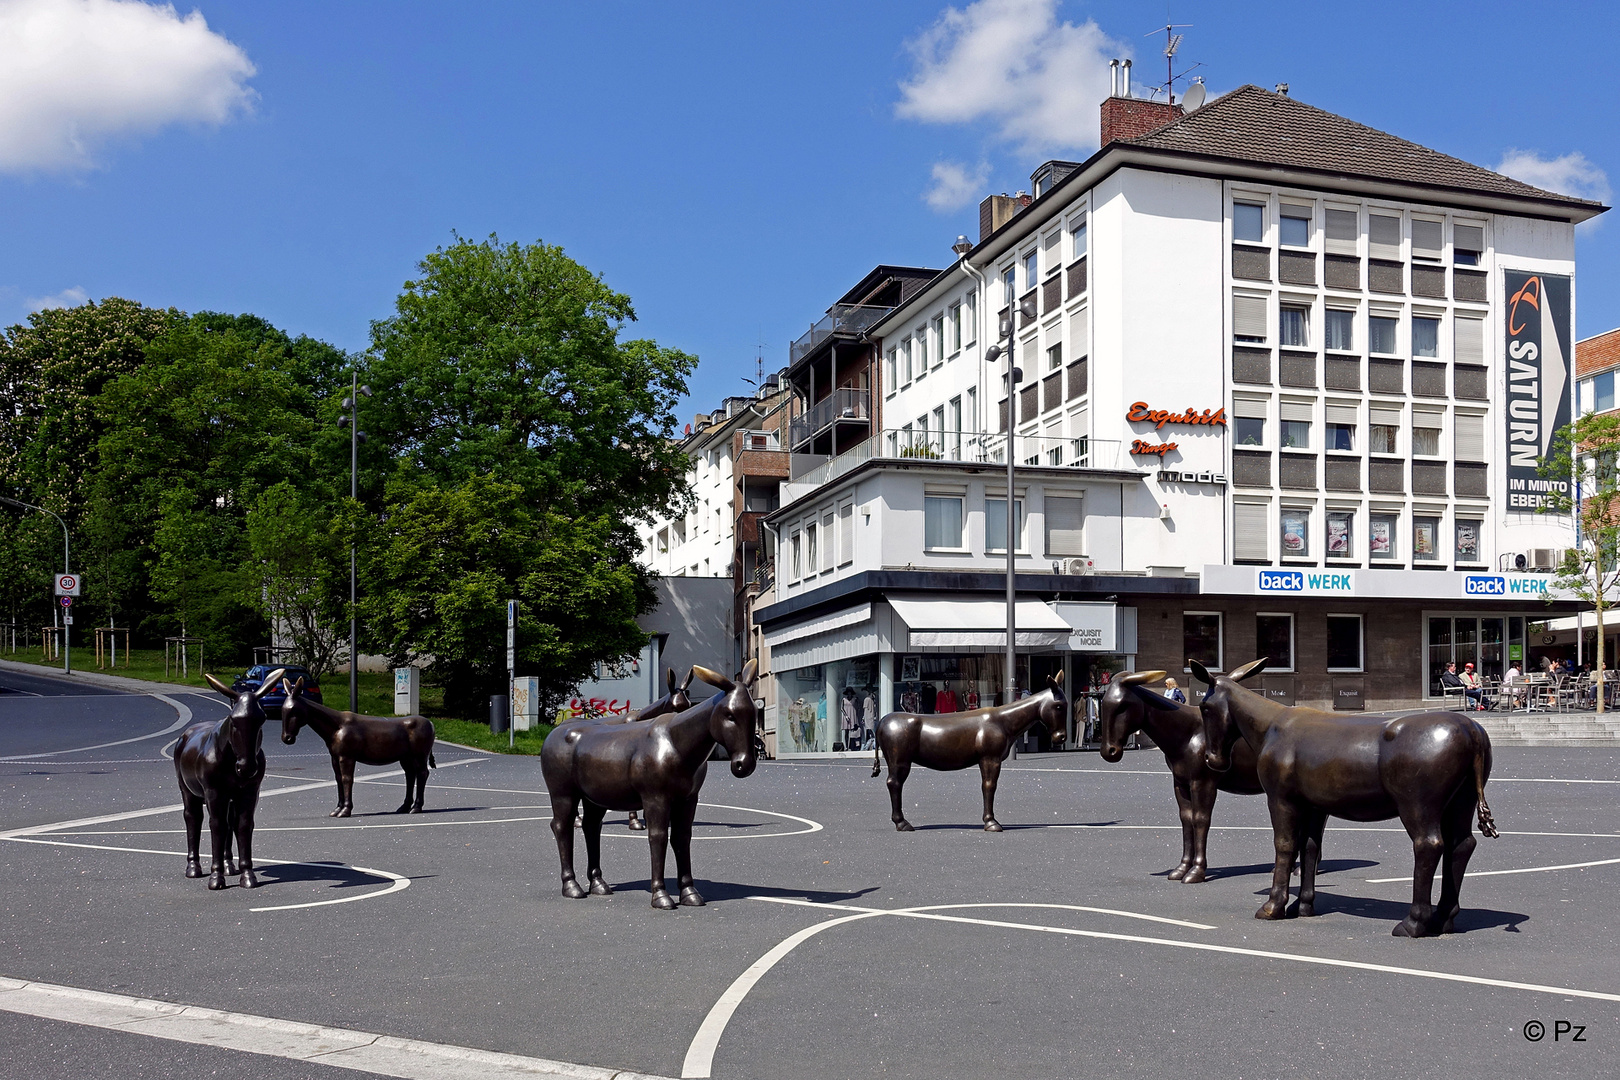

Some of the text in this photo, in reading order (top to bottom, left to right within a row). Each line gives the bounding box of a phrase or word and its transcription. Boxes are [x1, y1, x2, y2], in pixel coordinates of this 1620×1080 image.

[1509, 340, 1538, 467] SATURN
[1127, 401, 1227, 430] Exquisit
[1510, 479, 1568, 492] IM MINTO
[1510, 494, 1555, 508] EBENE
[1260, 573, 1351, 590] back WERK
[1467, 578, 1548, 593] back WERK
[1070, 629, 1102, 637] XQUISIT
[1080, 638, 1102, 646] MODE
